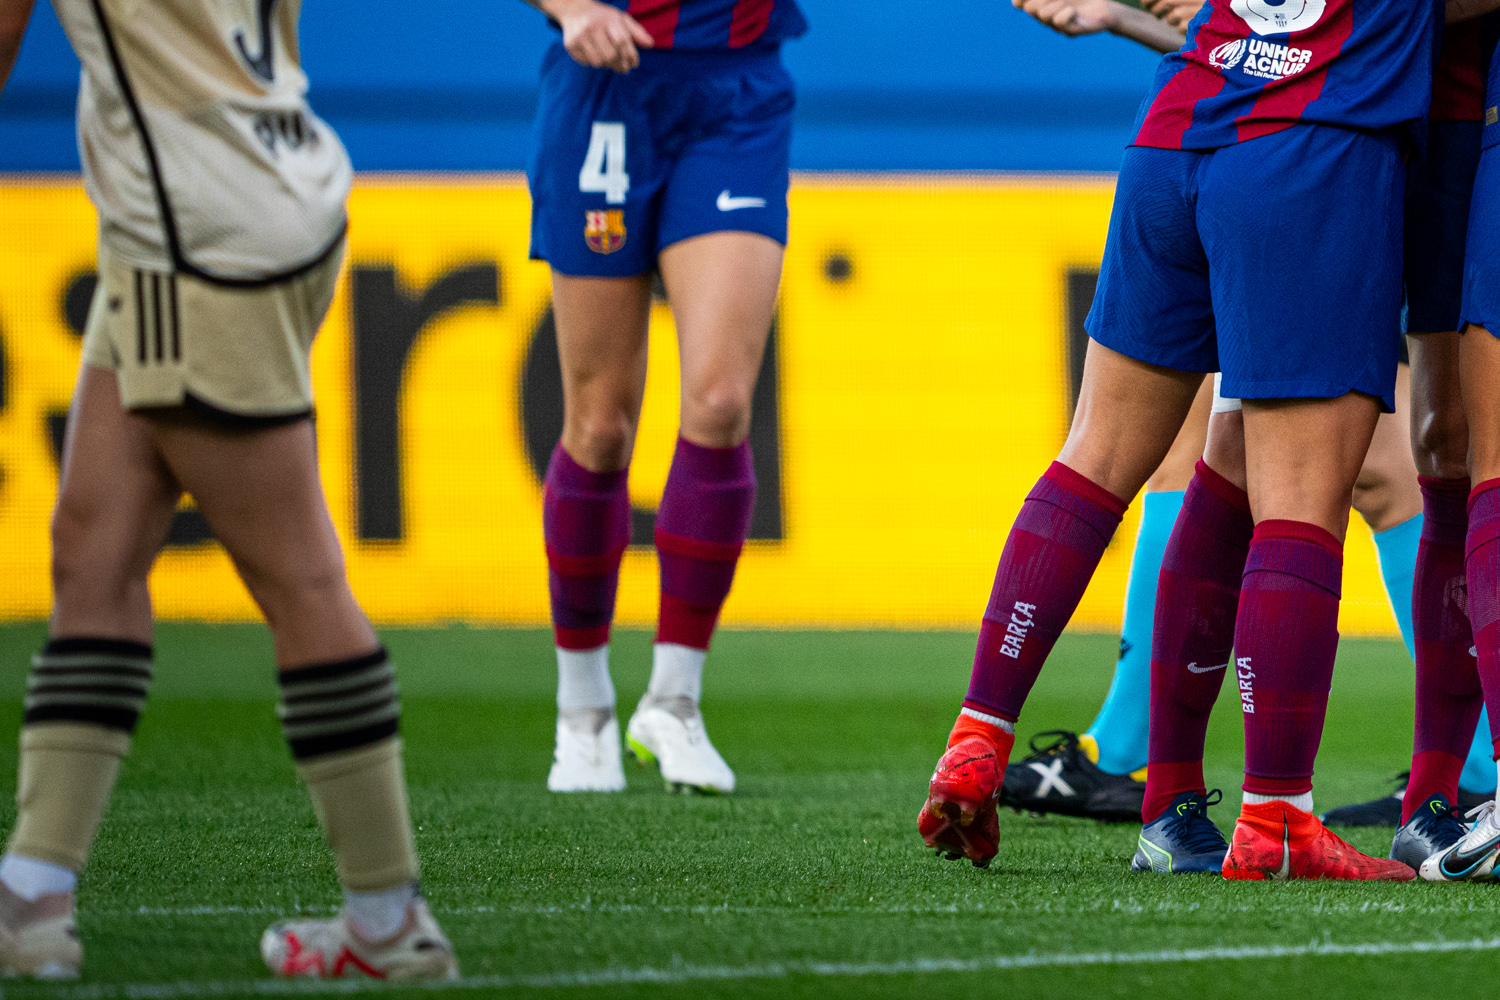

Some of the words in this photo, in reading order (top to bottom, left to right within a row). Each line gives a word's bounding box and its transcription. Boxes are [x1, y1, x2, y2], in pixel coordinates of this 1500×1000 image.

[1243, 54, 1307, 76] ACNUR
[1248, 39, 1313, 64] UNHCR
[579, 121, 630, 205] 4
[999, 600, 1037, 660] BARÇA
[1236, 656, 1256, 714] BARÇA
